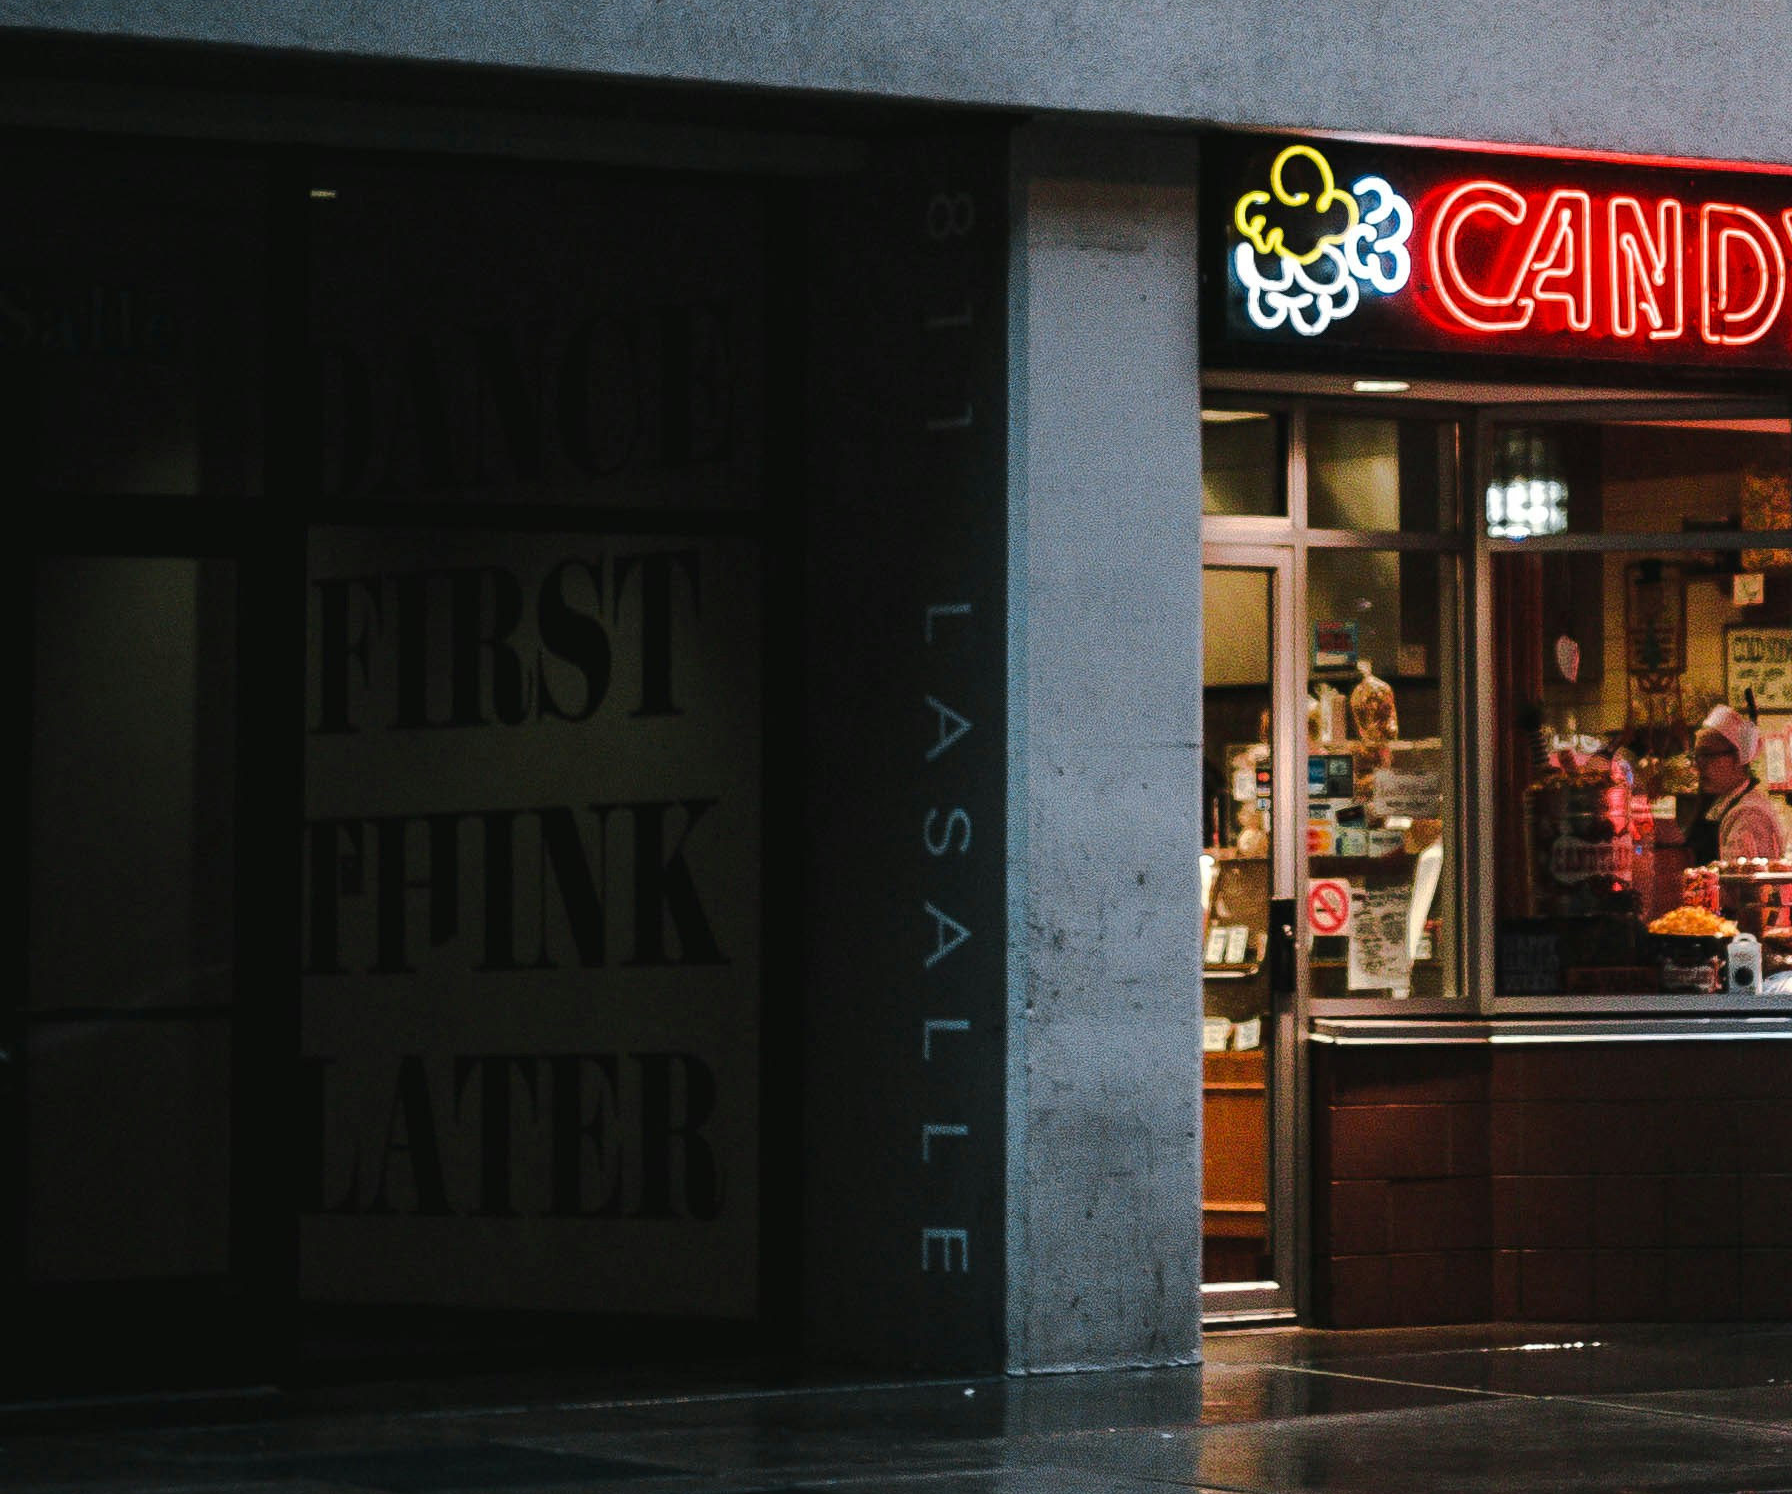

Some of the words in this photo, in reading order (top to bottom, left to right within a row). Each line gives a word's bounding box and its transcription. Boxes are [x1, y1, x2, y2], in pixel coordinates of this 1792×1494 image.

[926, 192, 975, 430] 811
[308, 549, 702, 735] FIRST
[919, 602, 974, 1276] LASALLE
[301, 1052, 727, 1222] LATER
